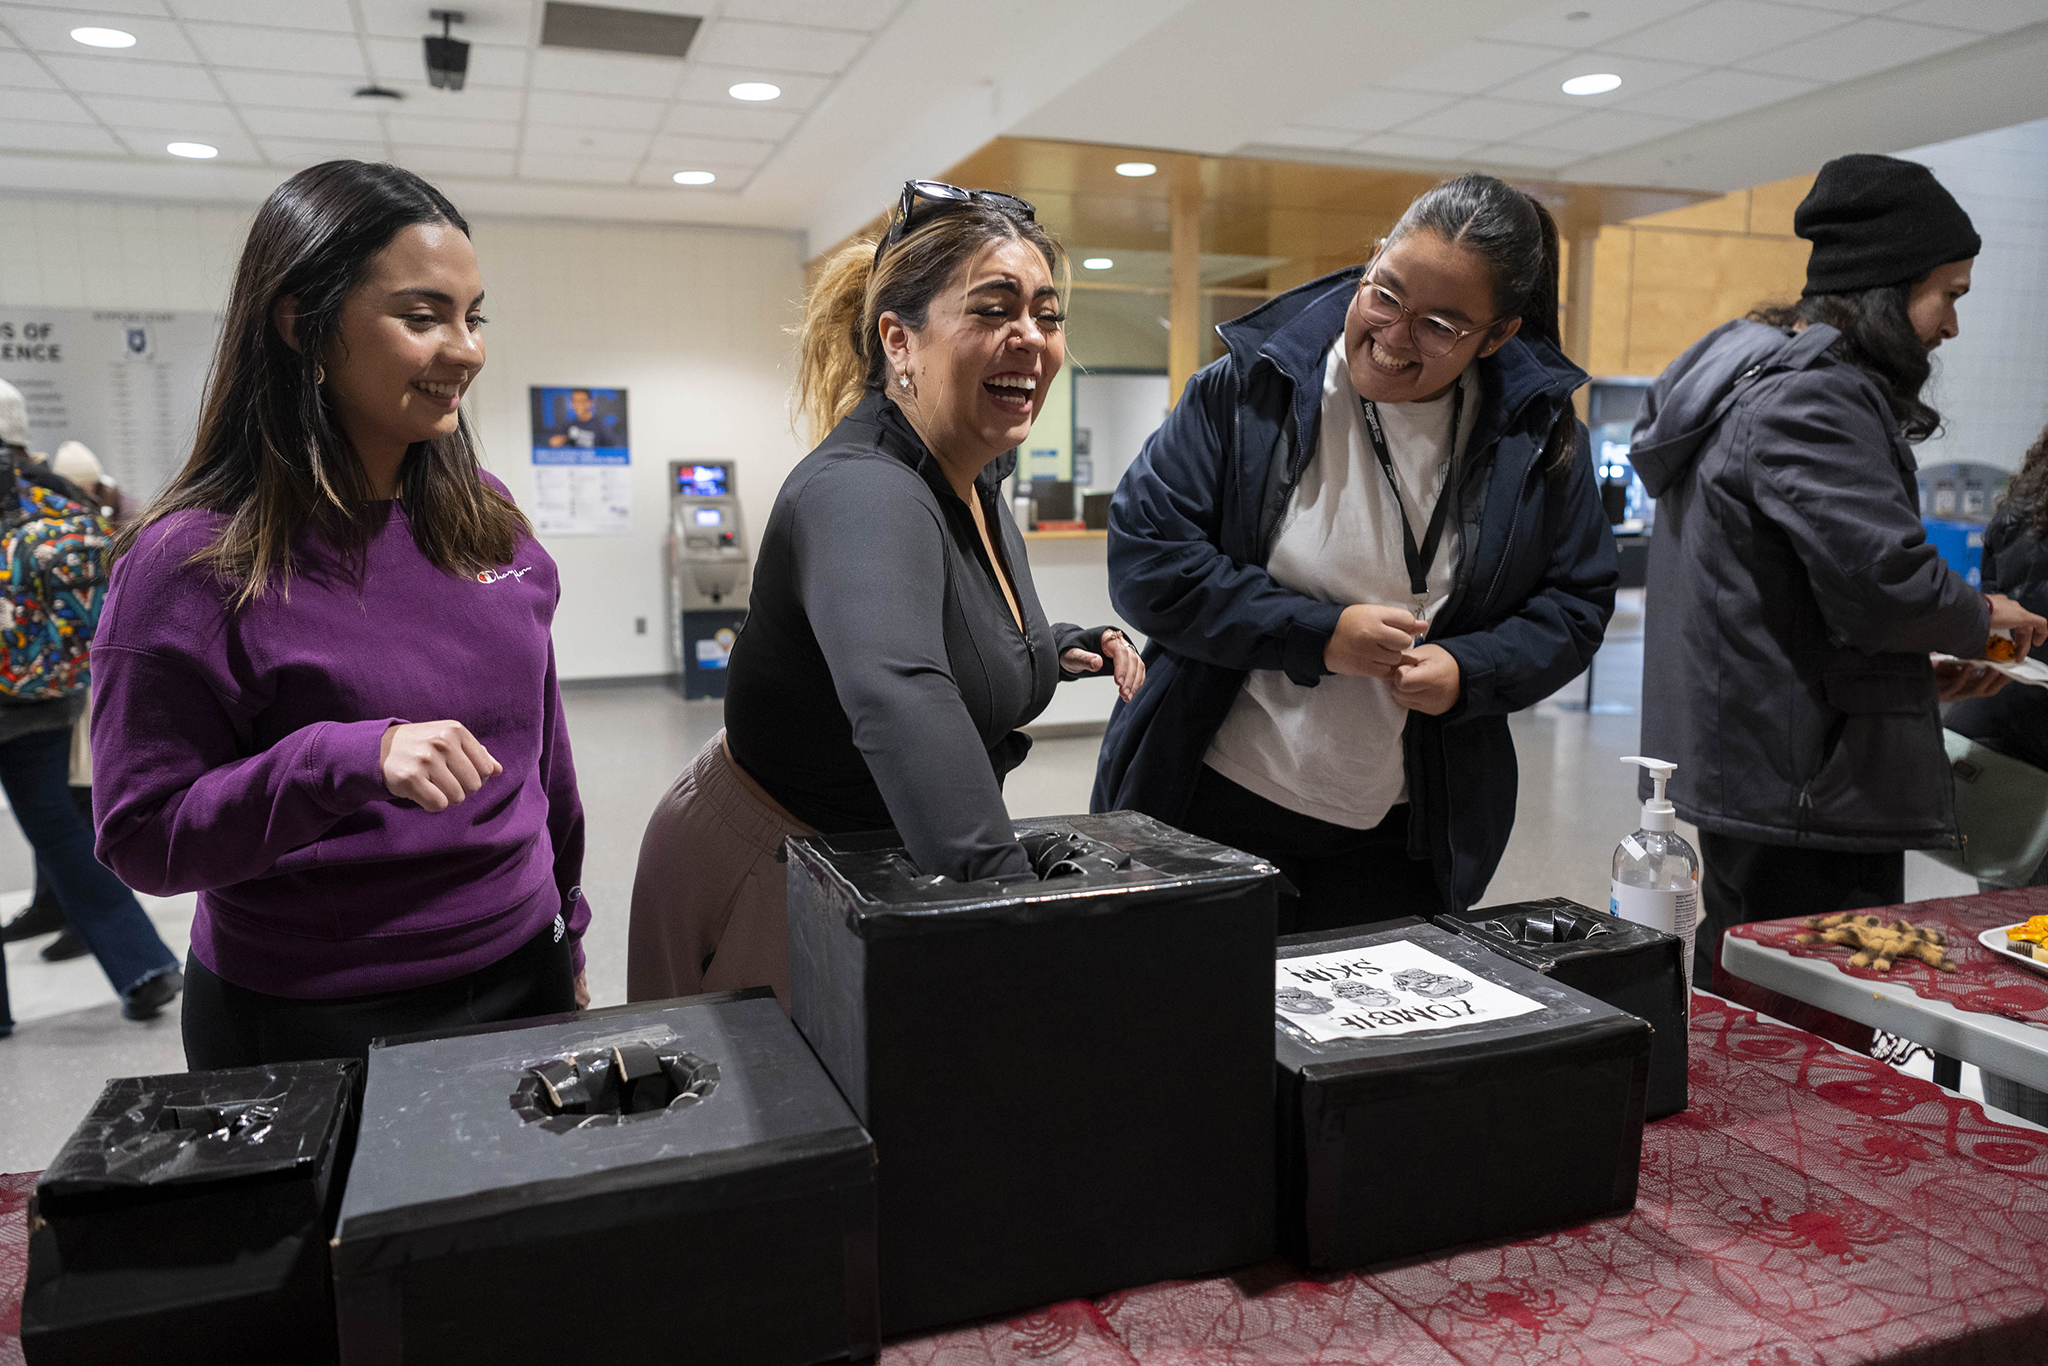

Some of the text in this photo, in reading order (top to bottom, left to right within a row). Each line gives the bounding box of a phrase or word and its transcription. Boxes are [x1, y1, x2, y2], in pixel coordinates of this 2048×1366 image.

[24, 322, 52, 341] OF
[2, 343, 62, 363] ENCE
[1364, 401, 1380, 430] Regent
[1283, 958, 1383, 984] SKIN
[1337, 998, 1477, 1030] ZOMBIE
